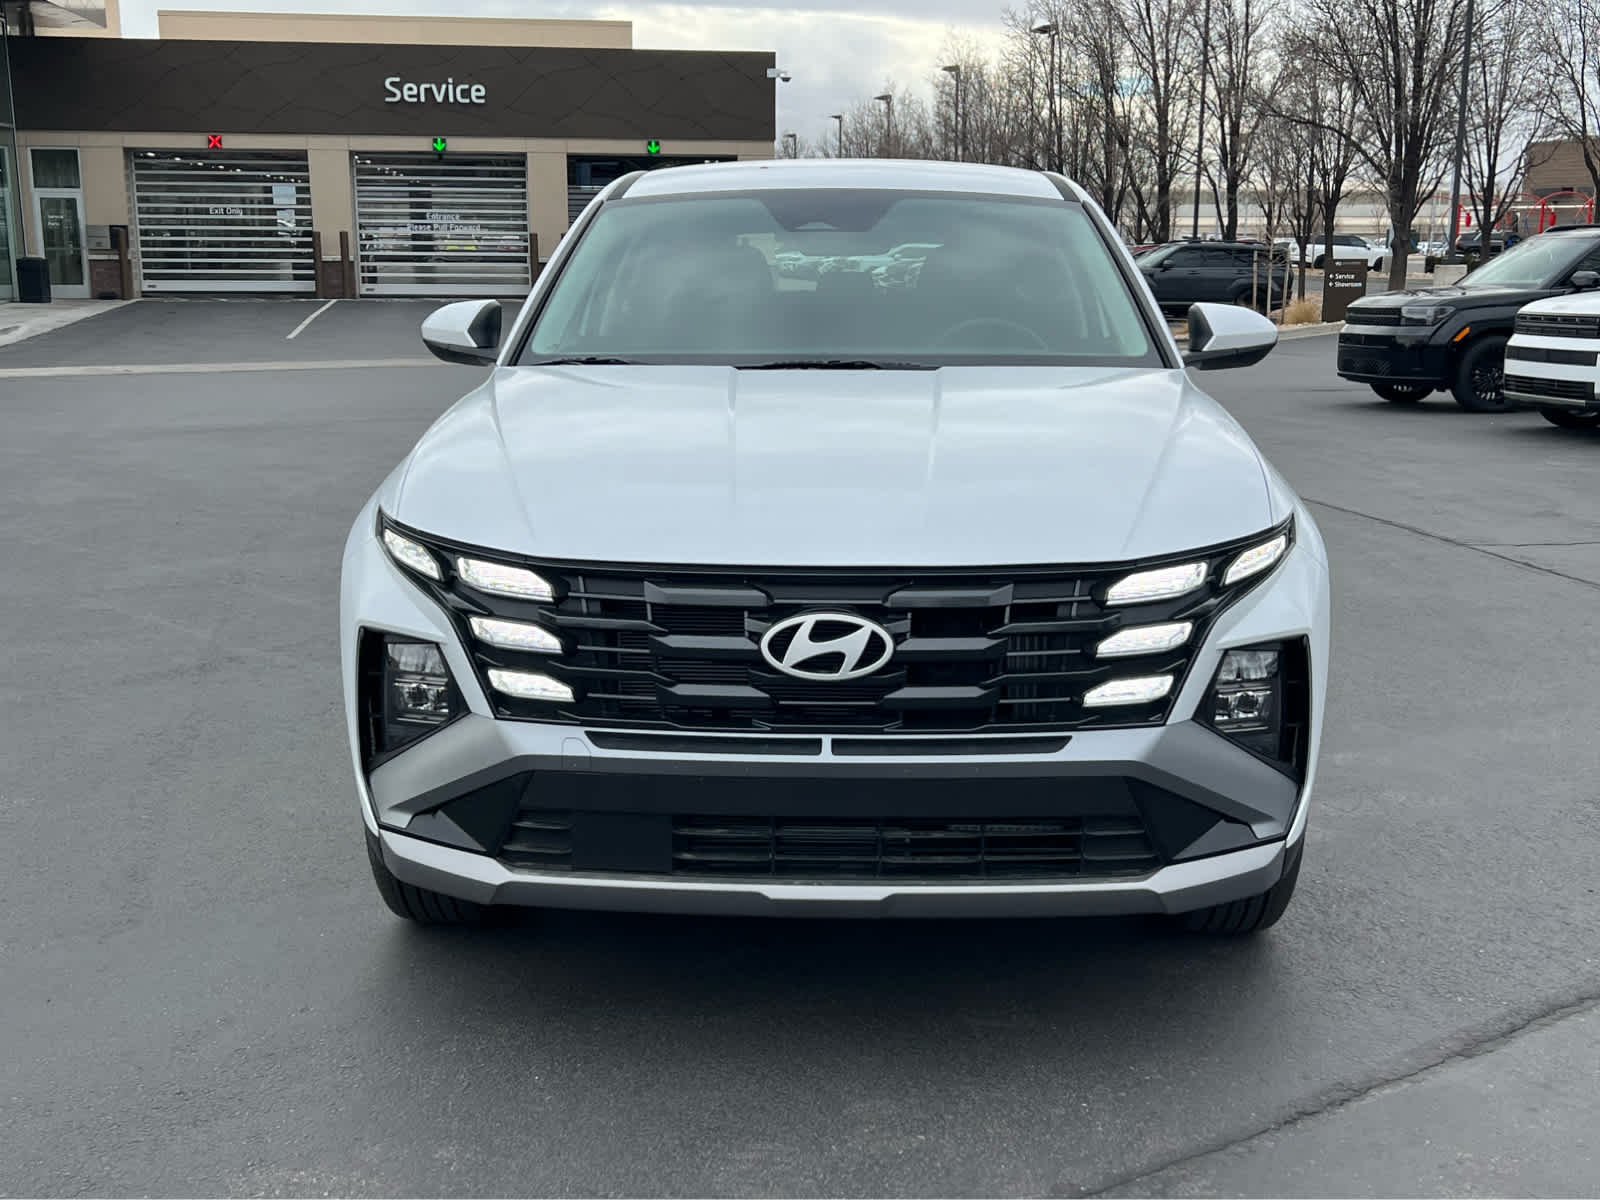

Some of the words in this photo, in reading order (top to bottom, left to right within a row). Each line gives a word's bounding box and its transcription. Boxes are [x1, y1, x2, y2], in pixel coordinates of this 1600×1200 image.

[384, 76, 487, 104] Service
[209, 207, 225, 215] Exit
[226, 207, 243, 217] Only
[426, 211, 460, 221] Entrance
